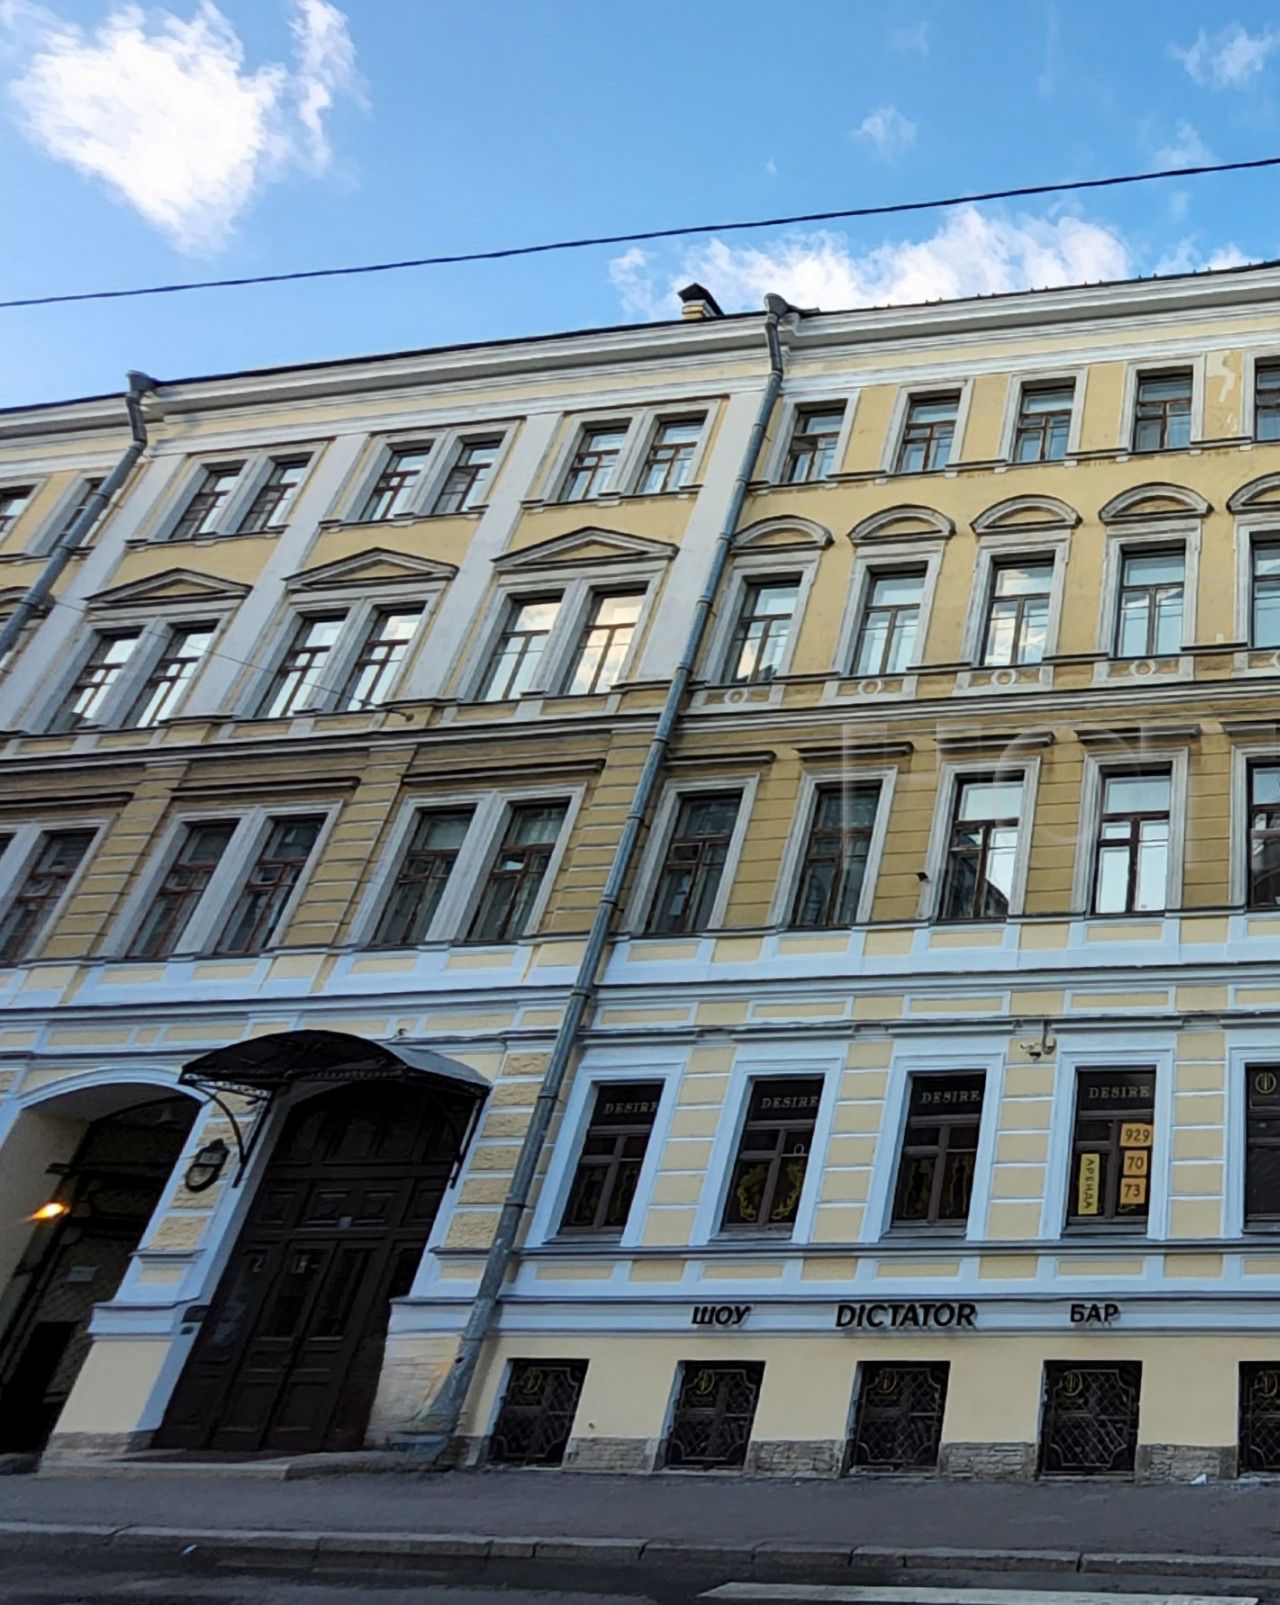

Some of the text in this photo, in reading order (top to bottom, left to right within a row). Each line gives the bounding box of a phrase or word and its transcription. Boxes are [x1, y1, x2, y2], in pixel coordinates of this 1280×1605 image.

[919, 1090, 981, 1104] DESIRE
[1088, 1085, 1151, 1099] DESIRE
[760, 1095, 818, 1109] DESIRE
[1124, 1127, 1151, 1143] 929
[1126, 1155, 1145, 1171] 70
[1082, 1156, 1096, 1209] АРЕНДА
[1123, 1183, 1142, 1198] 73
[690, 1305, 752, 1326] ШОУ
[834, 1303, 978, 1329] DICTATOR
[1070, 1303, 1121, 1324] БАР
